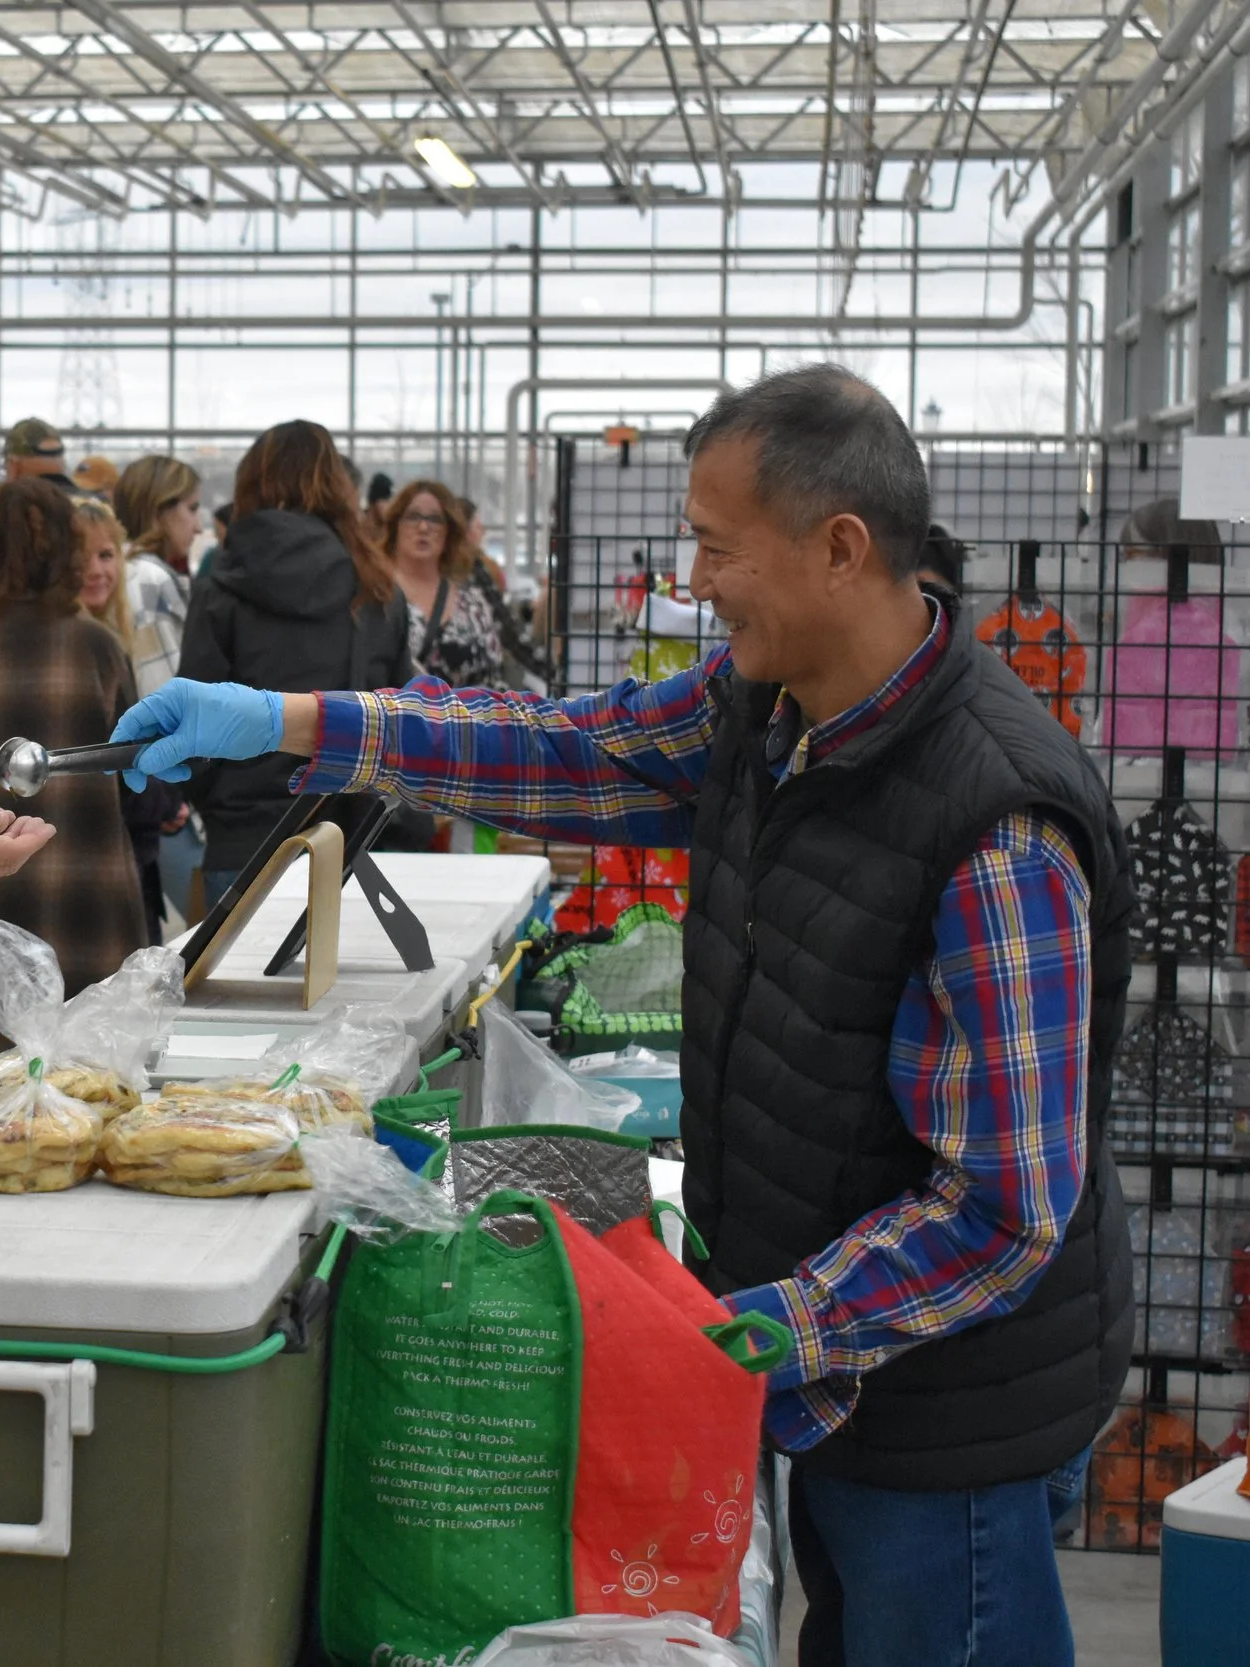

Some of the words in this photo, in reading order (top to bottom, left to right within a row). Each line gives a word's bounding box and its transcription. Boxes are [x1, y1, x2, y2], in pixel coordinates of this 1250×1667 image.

[385, 1316, 419, 1327] WATER
[478, 1325, 503, 1335] AND
[396, 1333, 407, 1343] IT
[408, 1335, 435, 1346] GOES
[501, 1344, 515, 1354] TO
[518, 1345, 544, 1356] KEEP
[476, 1361, 501, 1370] AND
[394, 1406, 453, 1421] CONSERVEZ
[456, 1413, 475, 1423] VOS
[478, 1416, 536, 1428] ALIMENTS
[407, 1425, 453, 1439] CHAUDS
[455, 1431, 471, 1441] OU
[437, 1446, 444, 1456] À
[379, 1458, 396, 1469] SAC
[399, 1461, 463, 1477] THERMIQUE
[467, 1469, 521, 1480] PRATIQUE
[370, 1475, 388, 1485] SON
[390, 1478, 441, 1493] CONTENU
[445, 1486, 474, 1495] FRAIS
[478, 1487, 491, 1495] ET
[494, 1485, 549, 1494] DÉLICIEUX
[377, 1493, 428, 1510] EMPORTEZ
[430, 1501, 451, 1511] VOS
[455, 1503, 511, 1512] ALIMENTS
[514, 1502, 544, 1511] DANS
[393, 1514, 409, 1525] UN
